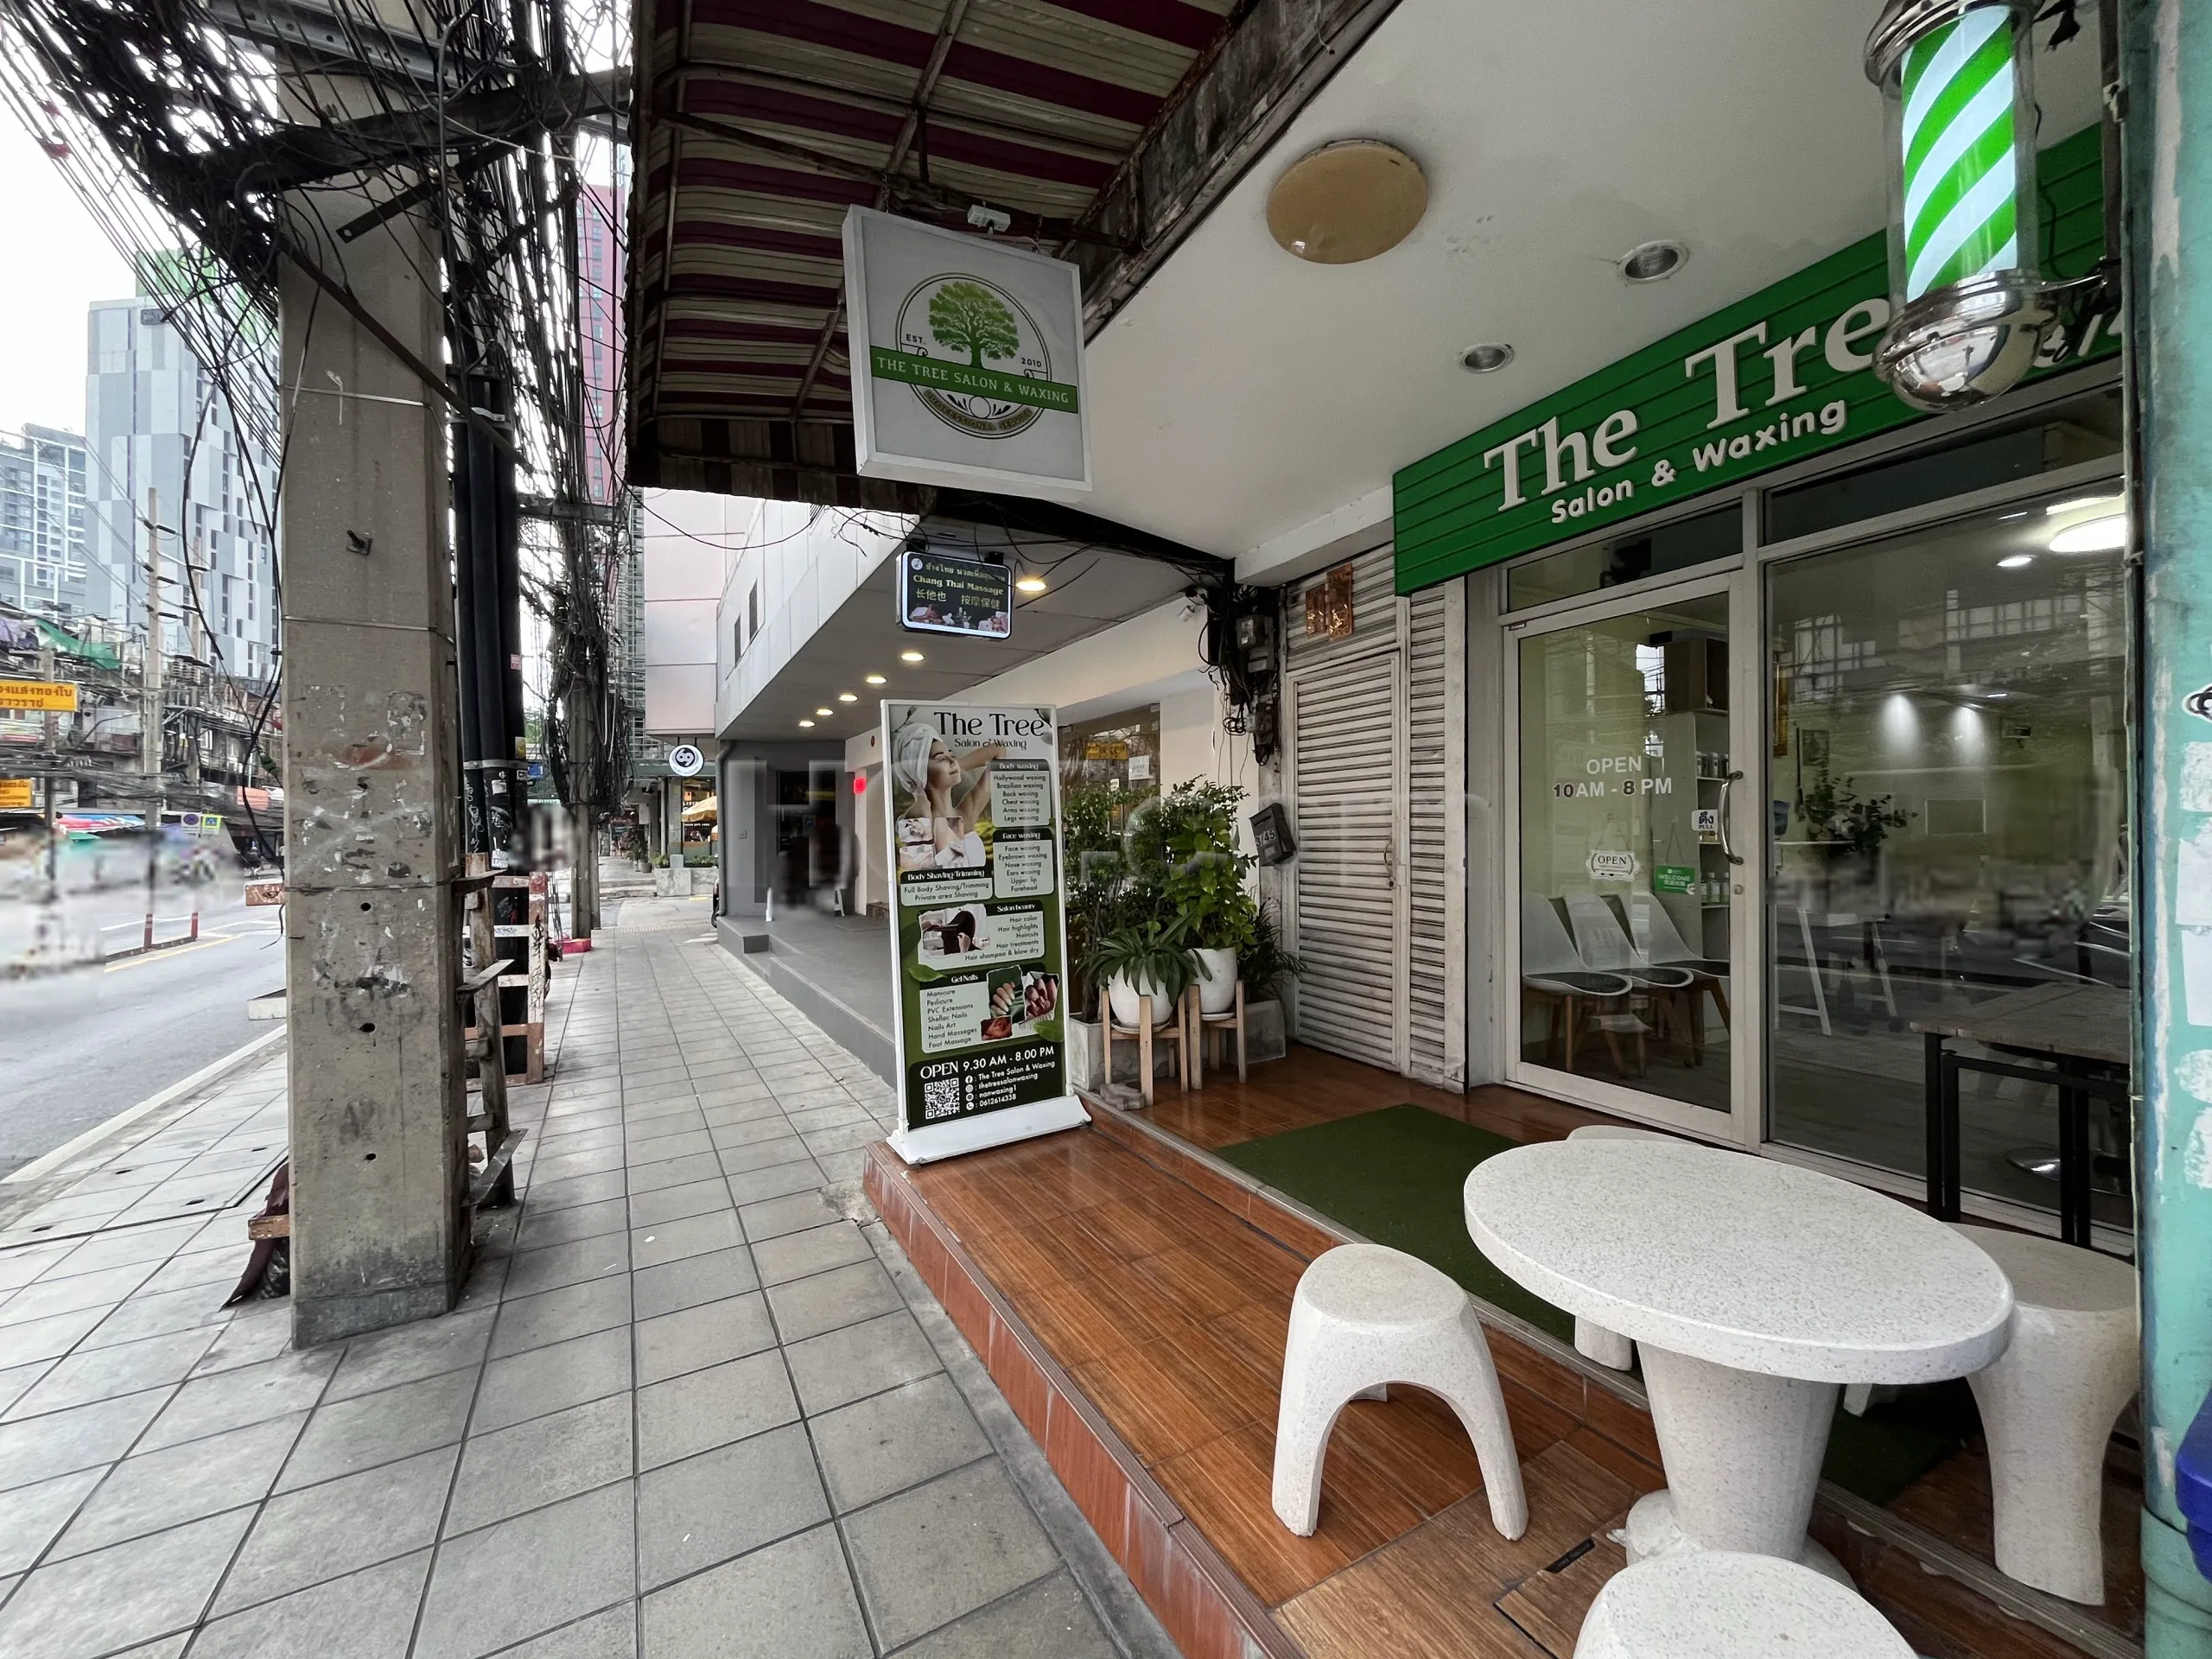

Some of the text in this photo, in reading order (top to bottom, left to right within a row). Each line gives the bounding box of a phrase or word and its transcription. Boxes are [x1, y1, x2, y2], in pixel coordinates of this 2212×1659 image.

[906, 334, 926, 345] EST.
[1021, 357, 1042, 367] 2010
[1685, 298, 1890, 429] Tre
[877, 357, 1069, 404] THE TREE SALON & WAXING
[923, 390, 996, 430] PROFESSIONAL
[1484, 410, 1638, 512] The
[1552, 479, 1634, 523] Salon
[1651, 460, 1677, 486] &
[913, 575, 1004, 596] Chang Thai Massage
[916, 588, 1001, 610] 长他也 按摩保健
[934, 711, 1045, 736] The Tree
[955, 738, 980, 747] Salon
[994, 739, 1027, 750] Waxing
[1586, 755, 1642, 774] OPEN
[1623, 779, 1636, 796] 8
[1641, 778, 1672, 795] PM
[1598, 855, 1627, 865] OPEN
[926, 869, 985, 880] Shaving/Trimming
[935, 882, 989, 891] Shaving/Trimming
[1012, 923, 1039, 932] highlights
[979, 950, 1007, 959] shampoo
[950, 975, 963, 983] Gel
[942, 1003, 974, 1012] Extensions
[927, 1014, 950, 1023] Shellac
[944, 1037, 971, 1046] Massage
[920, 1061, 959, 1079] OPEN
[963, 1058, 987, 1071] 9.30
[989, 1054, 1007, 1066] AM
[1015, 1049, 1037, 1062] 8.00
[1039, 1046, 1055, 1057] PM
[1032, 1061, 1055, 1070] Waxing
[979, 1072, 1038, 1089] thetreesalonwaxing
[979, 1084, 1017, 1098] nanwaxing1
